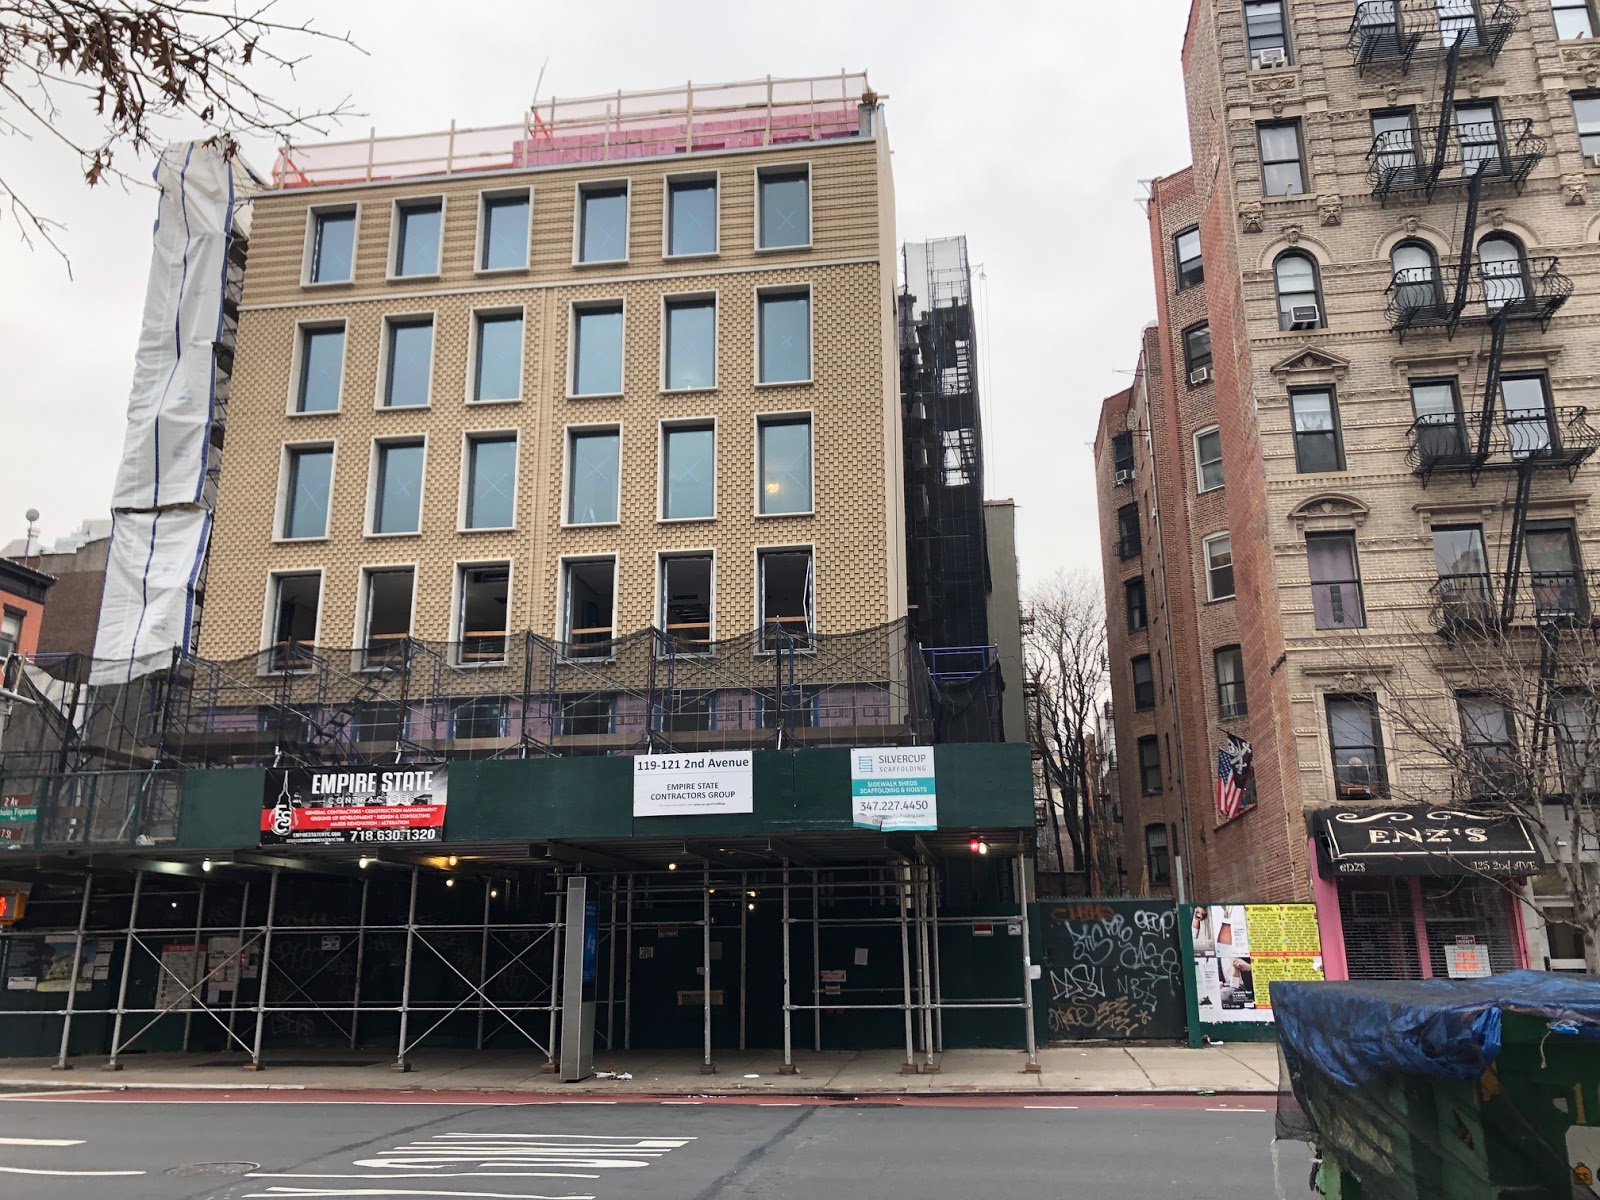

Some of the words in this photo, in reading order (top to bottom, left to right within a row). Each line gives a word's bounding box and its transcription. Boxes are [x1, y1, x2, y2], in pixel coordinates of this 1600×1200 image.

[637, 759, 681, 771] 119-121
[684, 758, 705, 769] 2nd
[707, 758, 749, 768] Avenue
[878, 754, 927, 764] SILVERCUP
[311, 772, 377, 795] EMPIRE
[381, 771, 433, 792] STATE
[666, 783, 696, 791] EMPIRE
[327, 794, 415, 805] CONTRACTORS
[650, 791, 706, 800] CONTRACTORS
[860, 800, 929, 811] 347.227.4450
[350, 829, 436, 842] 718.630.1320
[1368, 826, 1489, 844] ENZ'S
[1472, 861, 1491, 872] 125
